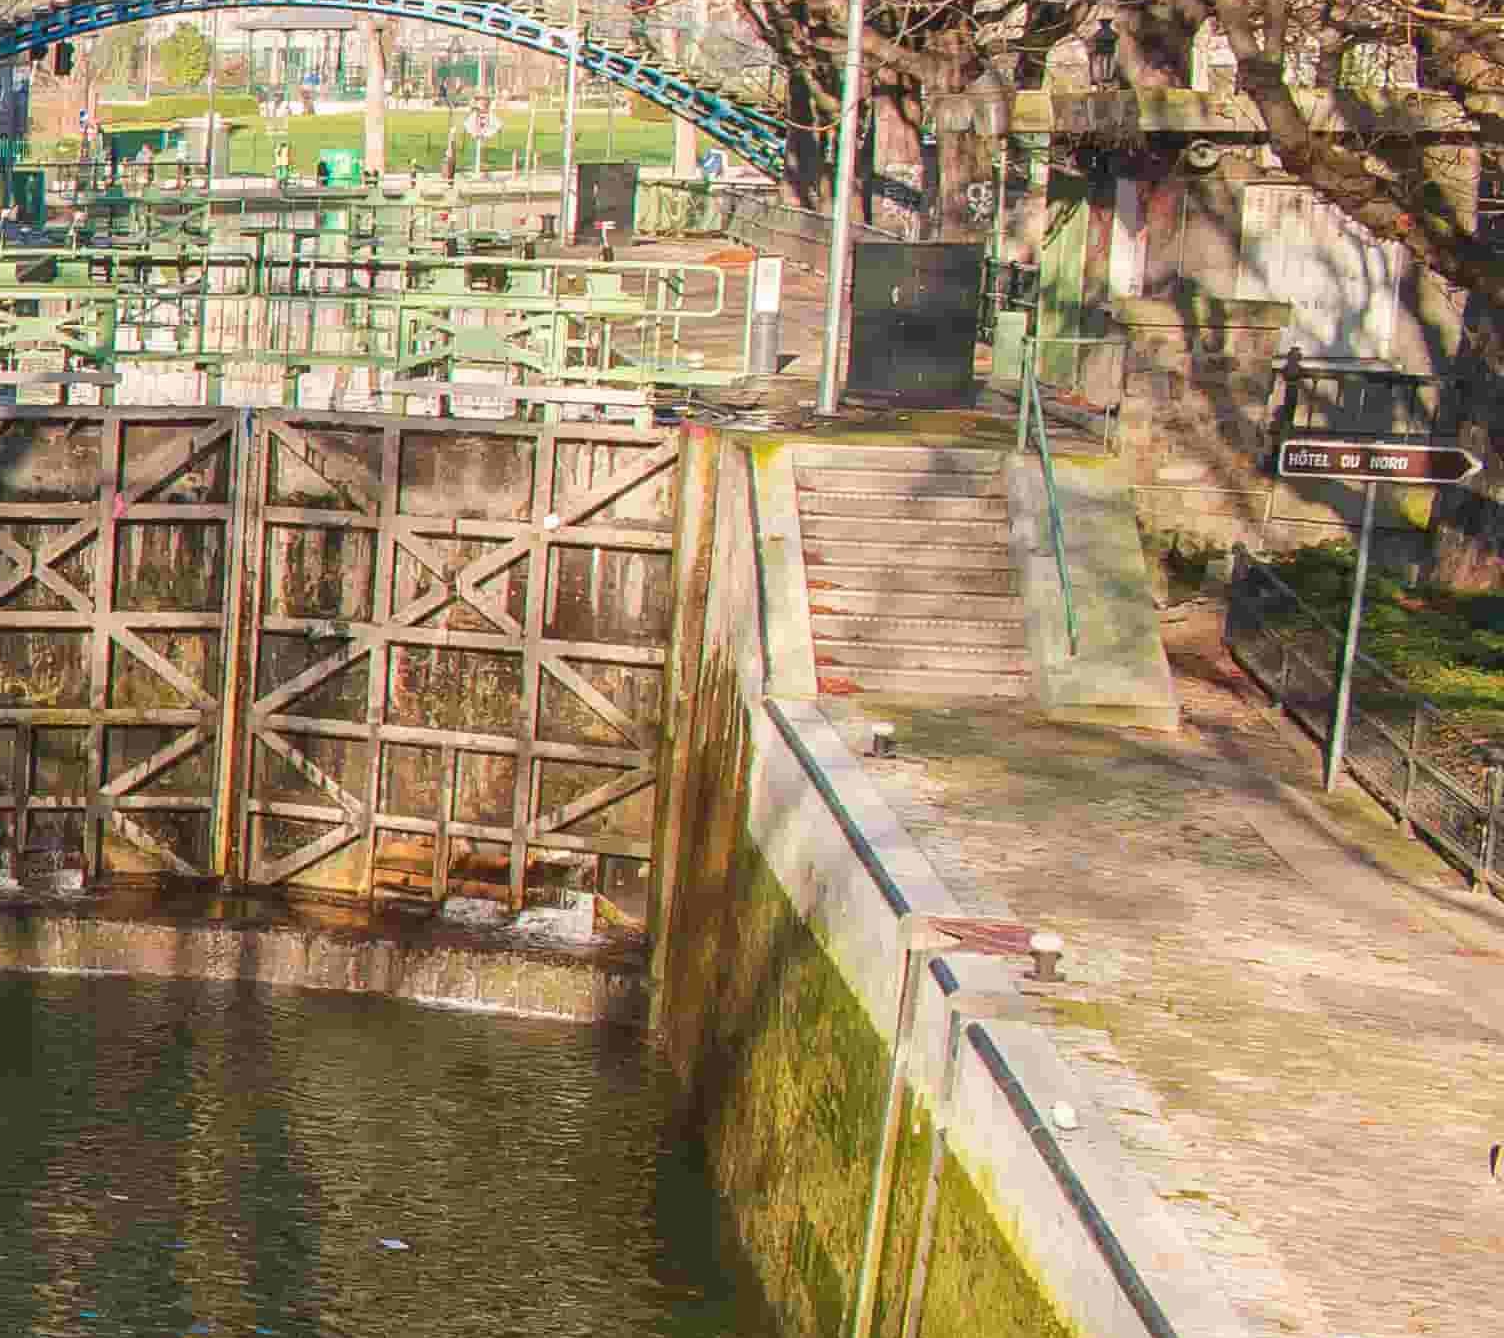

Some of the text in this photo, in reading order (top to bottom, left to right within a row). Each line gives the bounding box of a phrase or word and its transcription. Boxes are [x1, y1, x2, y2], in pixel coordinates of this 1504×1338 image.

[1288, 447, 1409, 470] HÔTEL DU NORD
